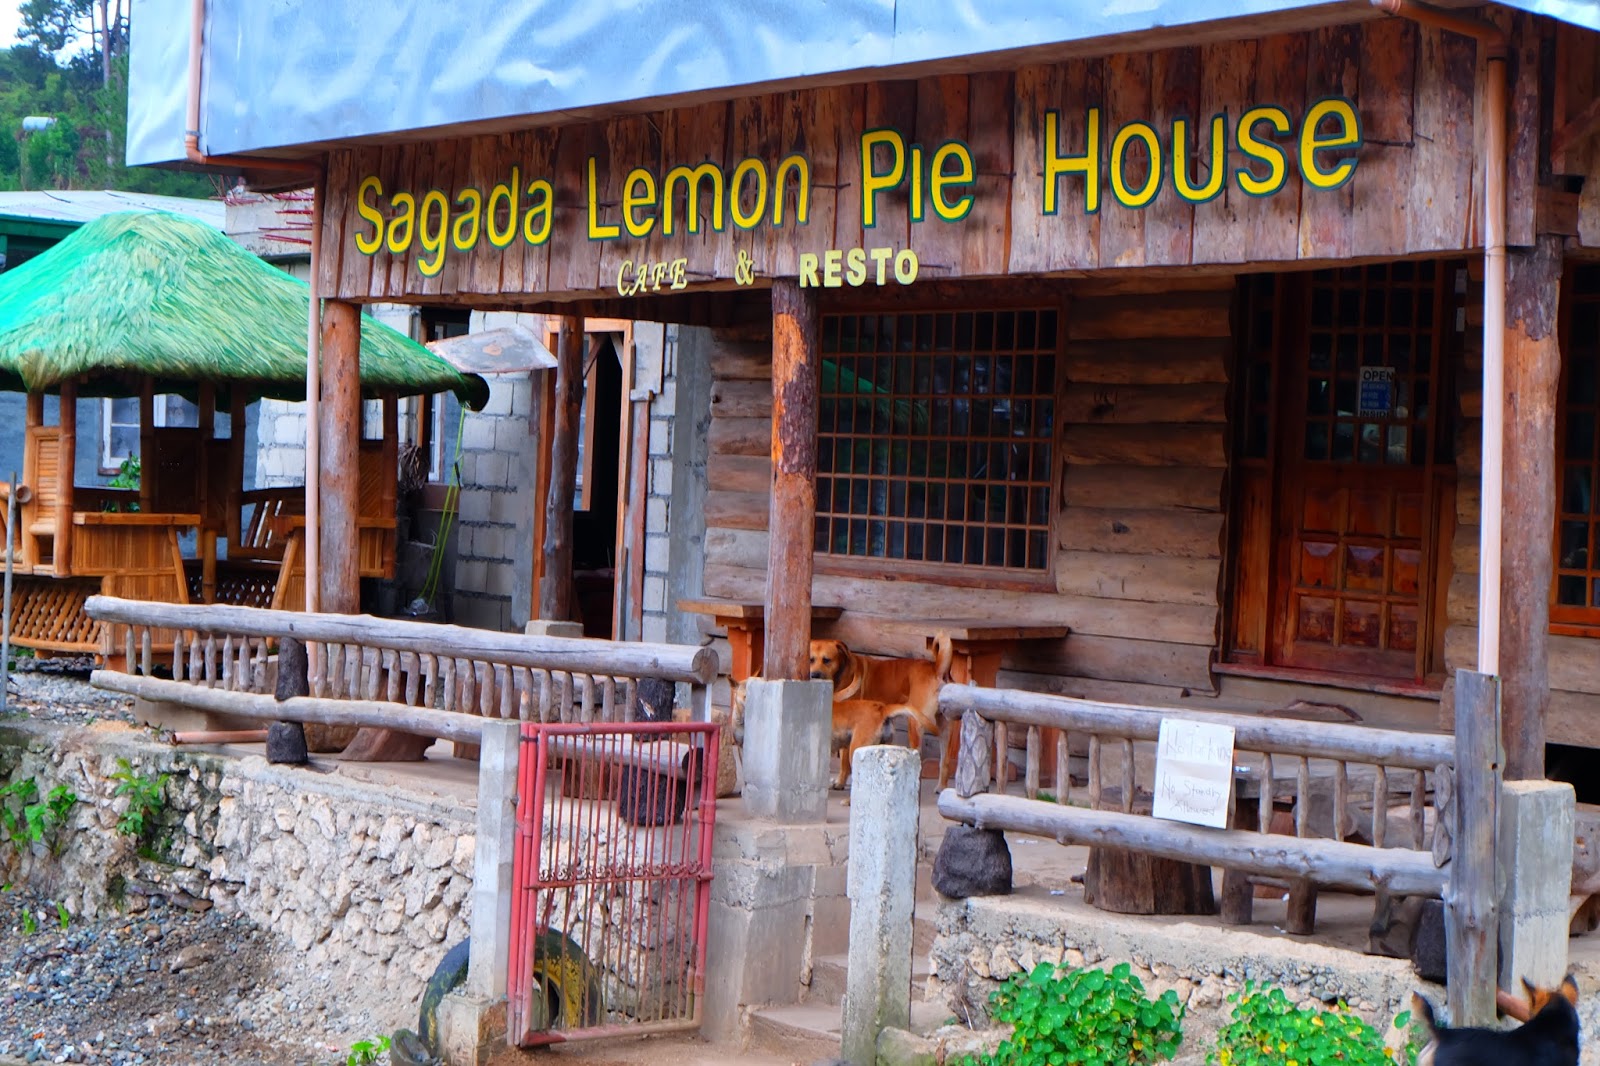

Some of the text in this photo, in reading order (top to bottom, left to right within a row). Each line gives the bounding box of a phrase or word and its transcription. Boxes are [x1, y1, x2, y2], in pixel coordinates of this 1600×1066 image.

[354, 96, 1363, 278] Sagada Lemon Pie House
[616, 247, 919, 297] CAFE & RESTO
[1363, 370, 1393, 381] OPEN
[1165, 727, 1184, 757] No
[1161, 771, 1176, 801] No
